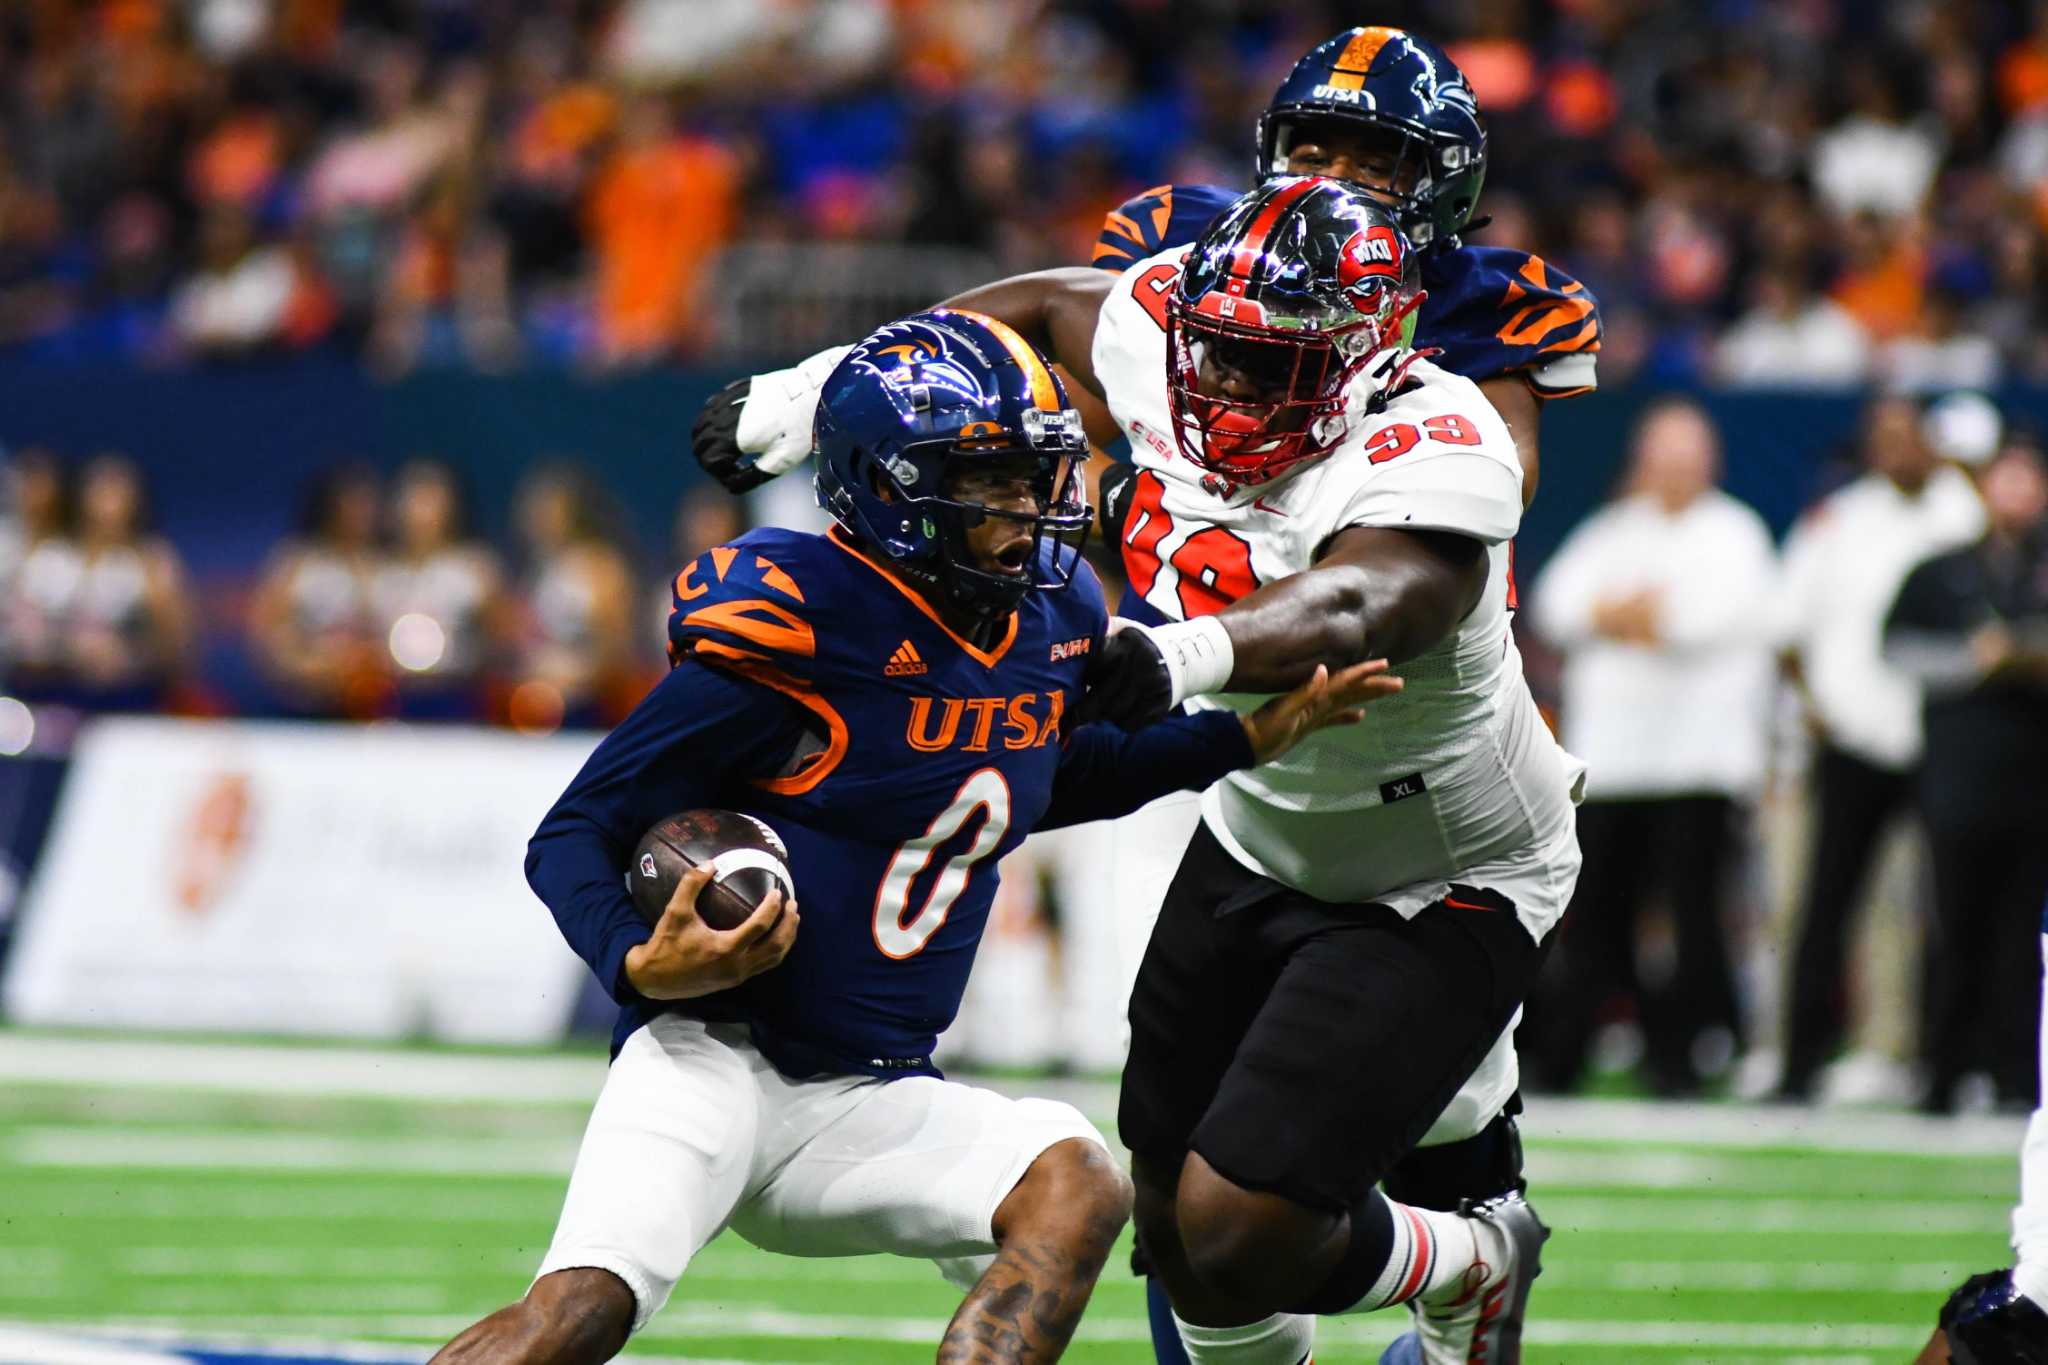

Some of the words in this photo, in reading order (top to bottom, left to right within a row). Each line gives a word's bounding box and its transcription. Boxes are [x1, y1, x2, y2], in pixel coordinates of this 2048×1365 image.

[1312, 84, 1360, 103] UTSA
[1352, 238, 1393, 264] WKU
[1364, 414, 1482, 466] 99
[906, 689, 1064, 752] UTSA
[1392, 782, 1416, 798] XL
[872, 767, 1011, 960] 0
